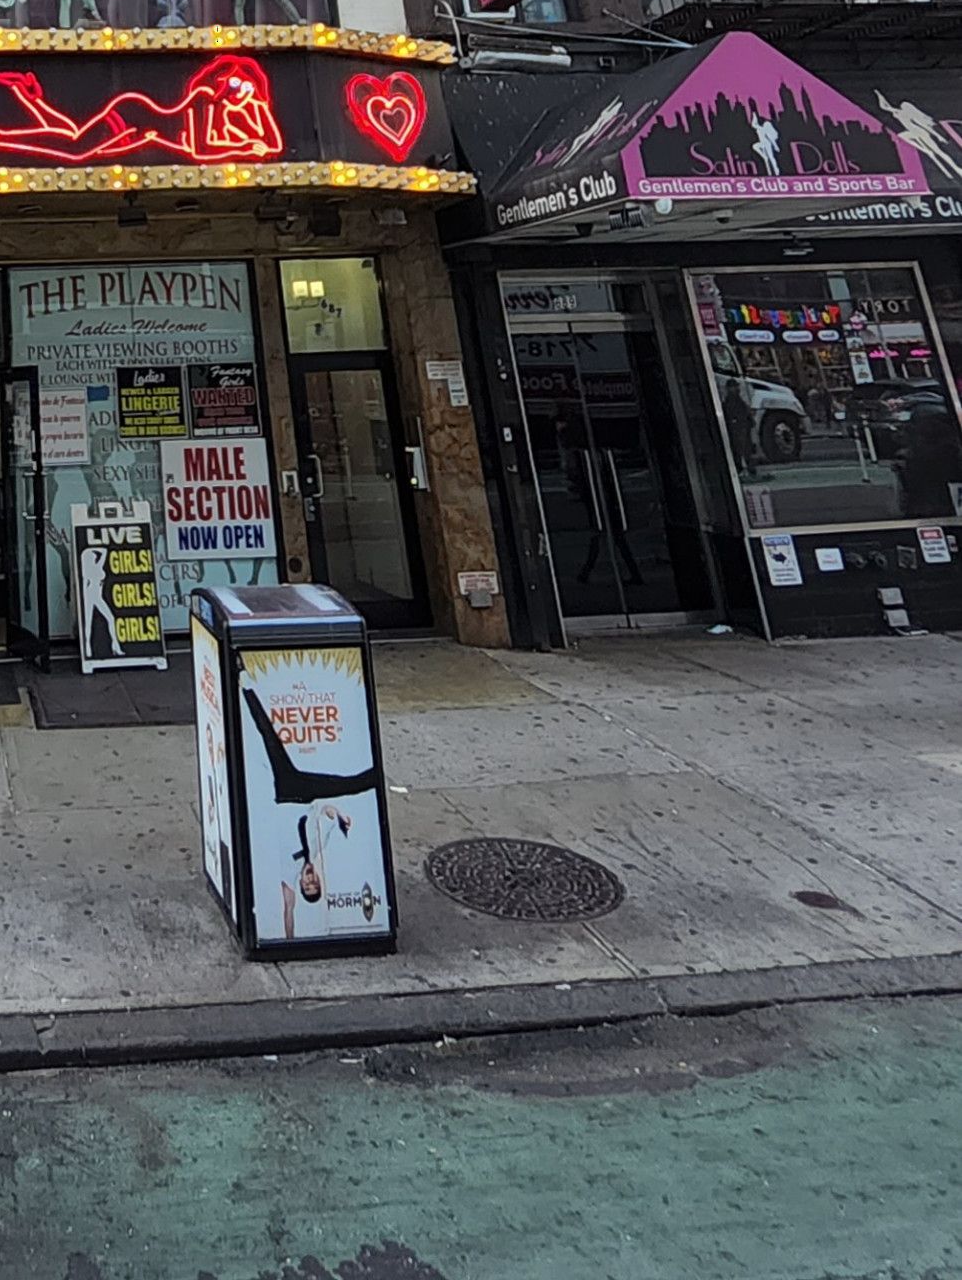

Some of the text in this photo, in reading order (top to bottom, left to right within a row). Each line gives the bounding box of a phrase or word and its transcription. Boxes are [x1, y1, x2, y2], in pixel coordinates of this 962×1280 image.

[690, 140, 861, 175] Satin Dolls
[638, 175, 916, 194] Gentlemen's Club and Sports Bar
[498, 170, 617, 226] Gentlemen's Club
[19, 270, 243, 319] THE PLAYPEN
[65, 318, 208, 337] Ladies Welcome
[27, 338, 239, 361] PRIVATE VIEWING BOOTHS
[121, 395, 181, 412] LINGERIE
[191, 385, 256, 408] WANTED
[183, 446, 247, 482] MALE
[166, 484, 271, 522] SECTION
[86, 525, 143, 545] LIVE
[178, 524, 265, 550] NOW OPEN
[109, 549, 152, 574] GIRLS!
[112, 582, 156, 608] GIRLS!
[116, 616, 160, 642] GIRLS!
[269, 692, 336, 706] SHOW THAT
[270, 705, 340, 725] NEVER
